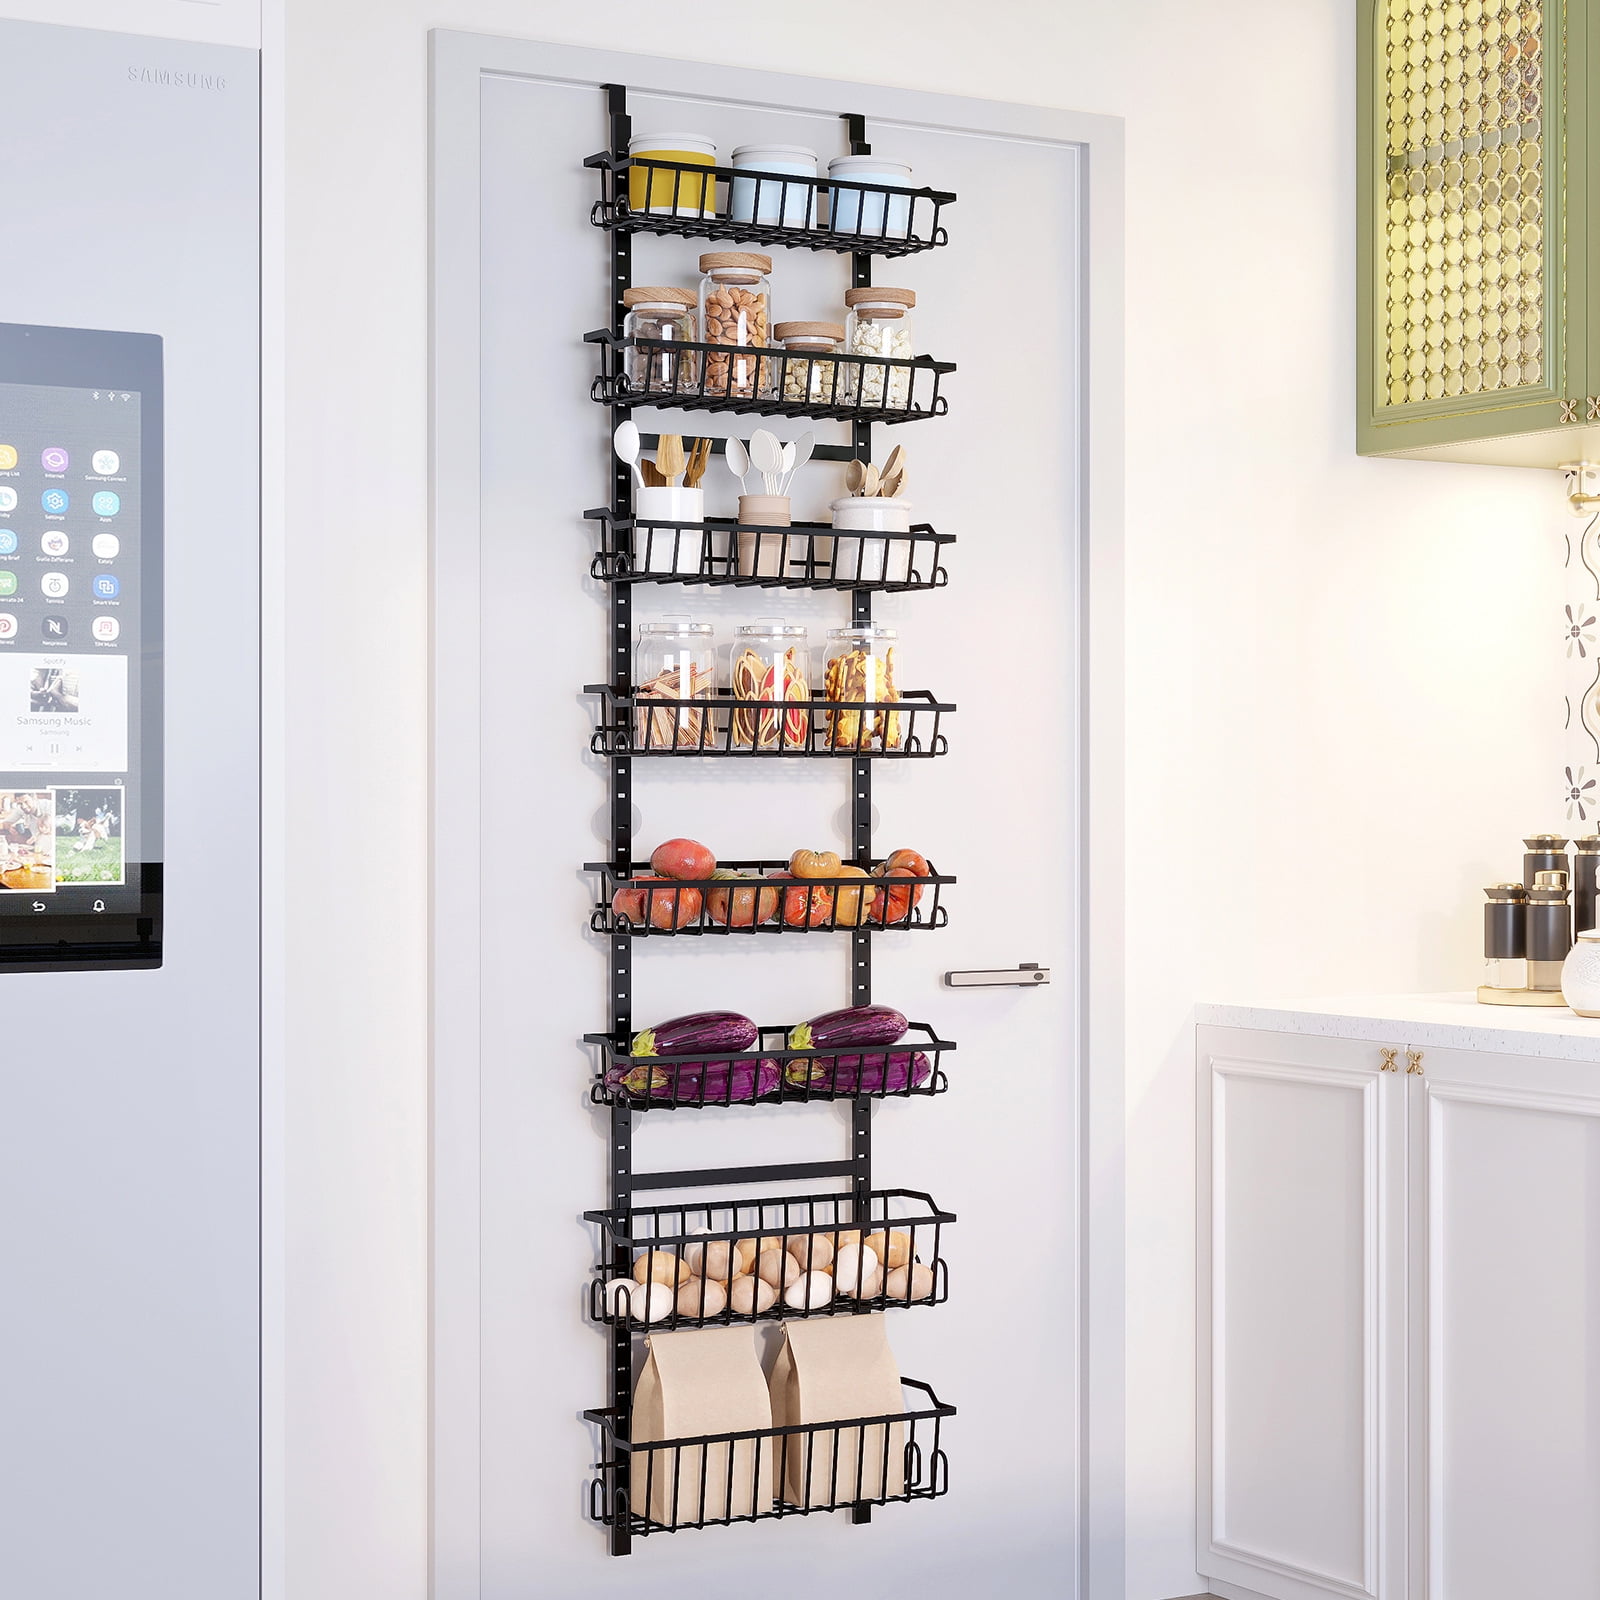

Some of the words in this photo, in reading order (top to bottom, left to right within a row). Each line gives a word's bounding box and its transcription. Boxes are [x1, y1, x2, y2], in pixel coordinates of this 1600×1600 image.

[127, 65, 227, 91] SAMSUNG
[43, 658, 66, 666] Spotify
[17, 716, 61, 727] Samsung
[64, 717, 92, 726] Music
[39, 729, 70, 737] Samsung
